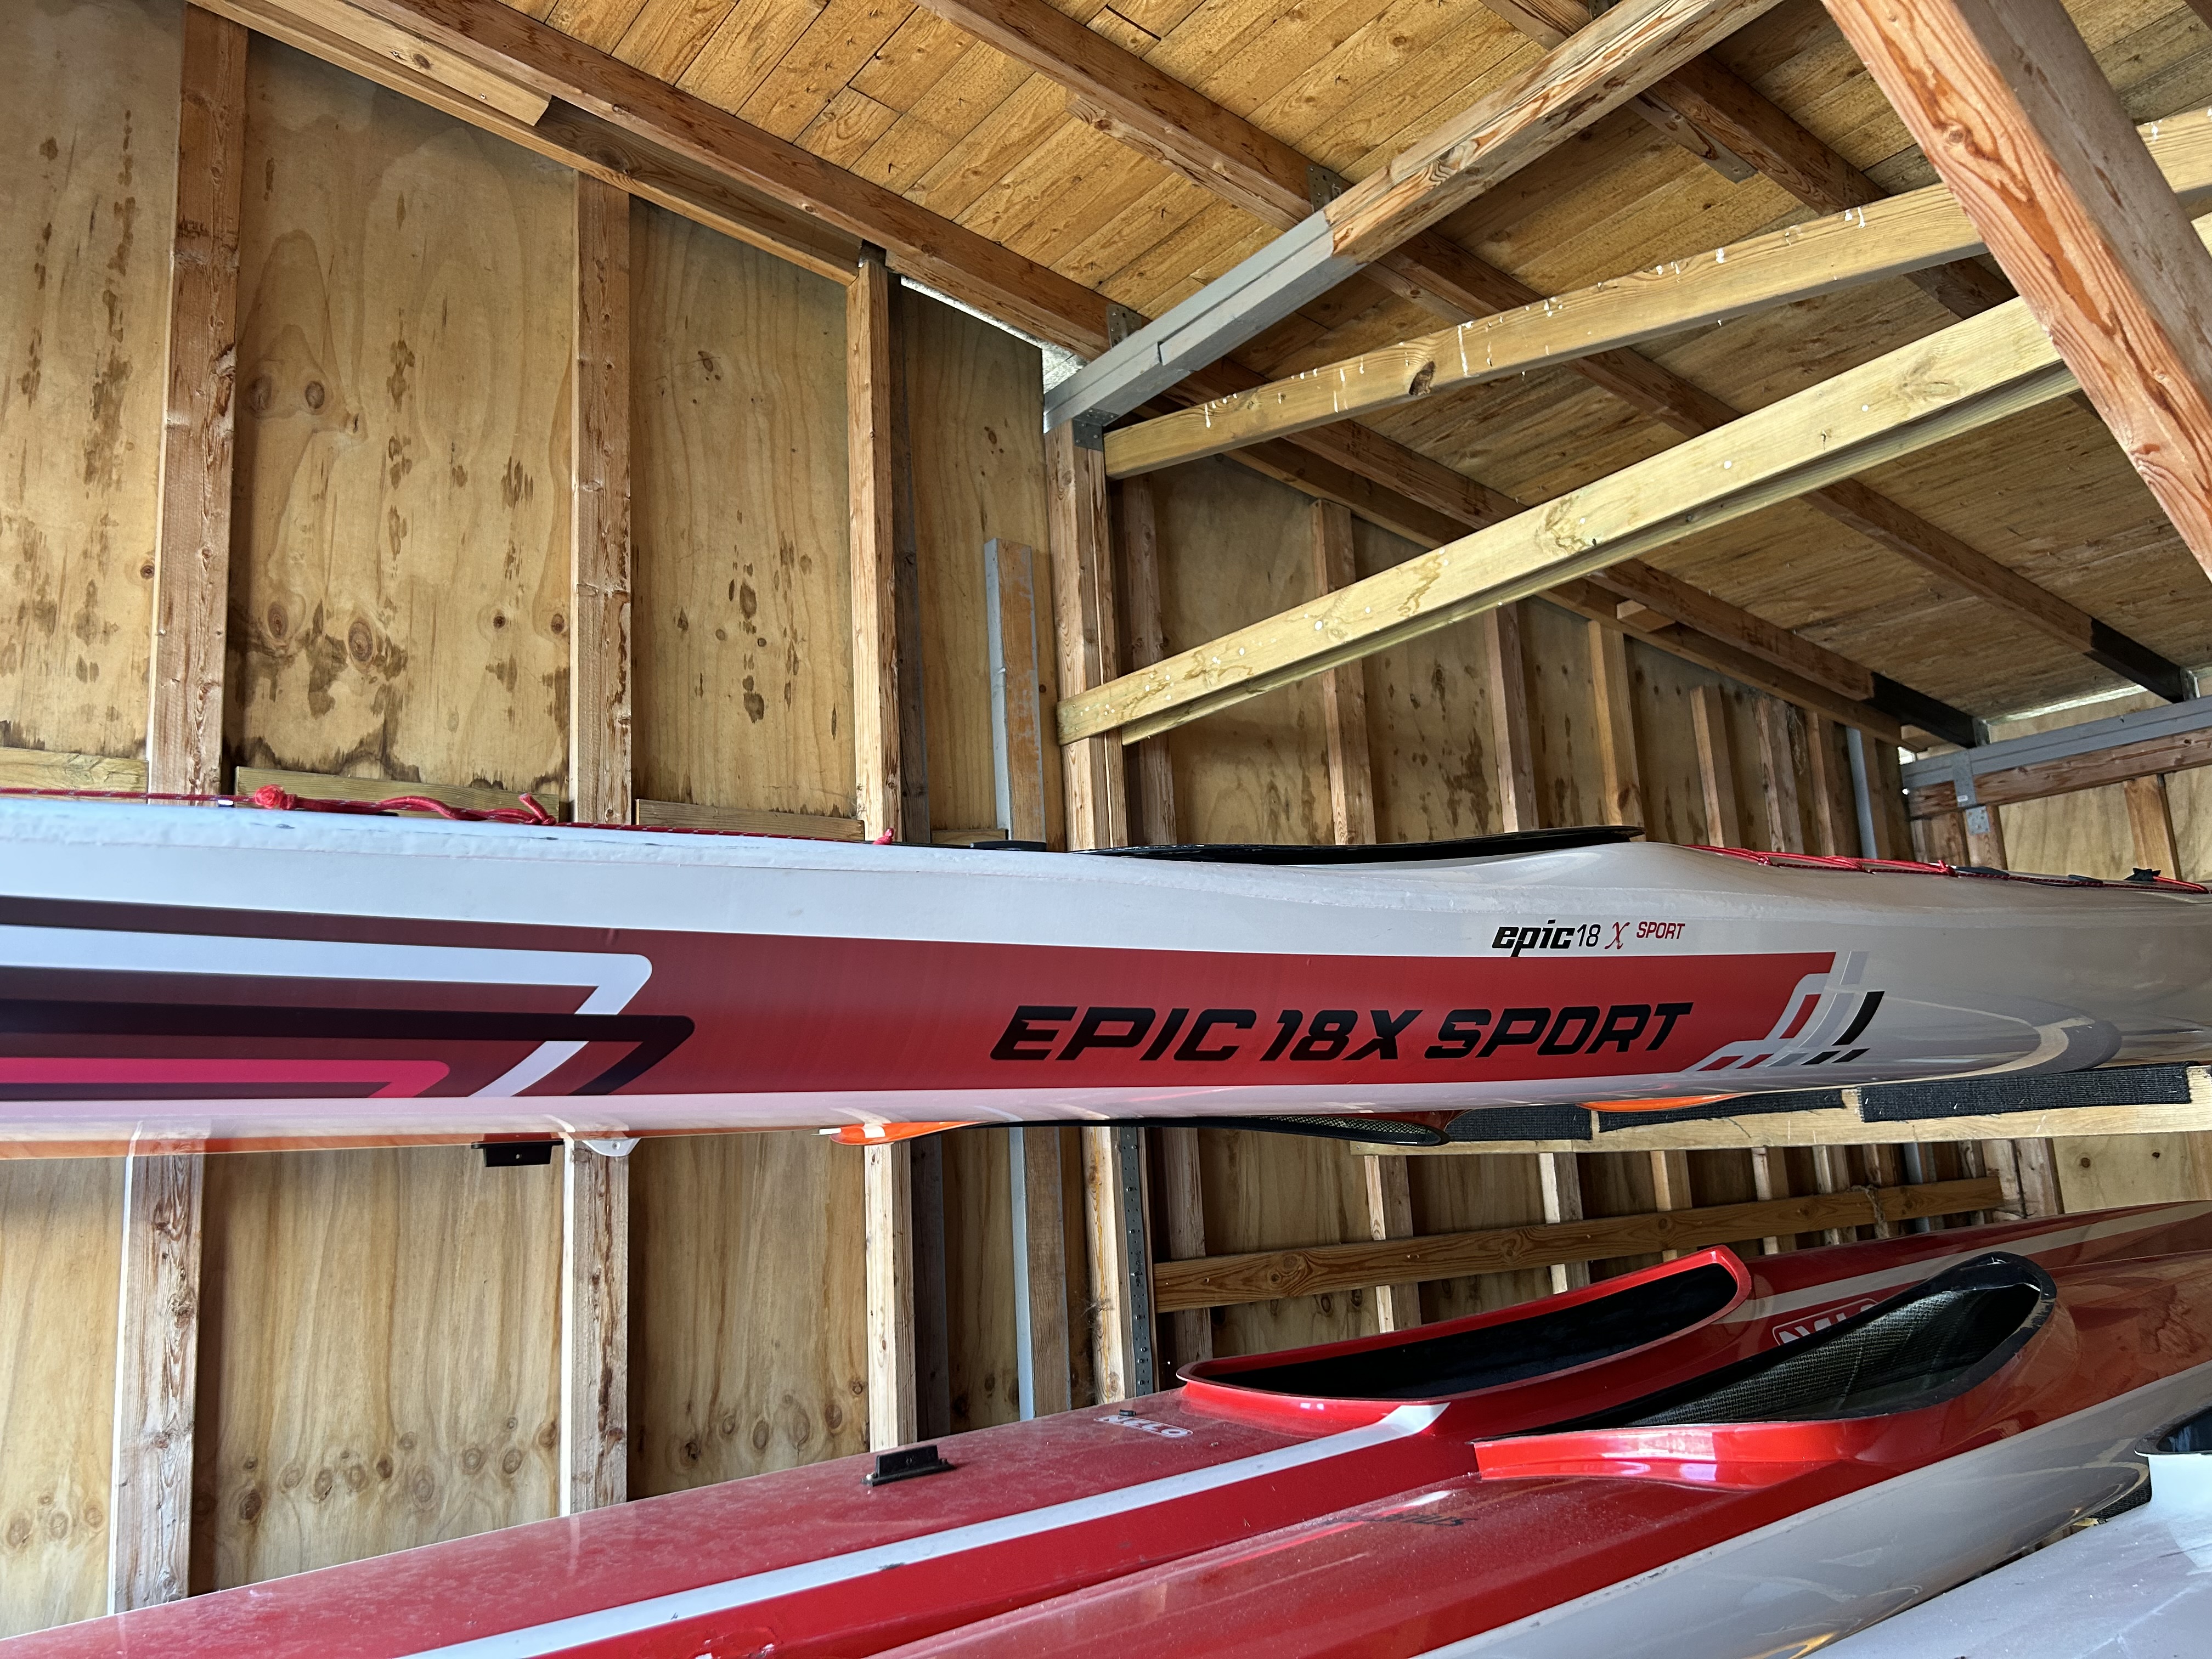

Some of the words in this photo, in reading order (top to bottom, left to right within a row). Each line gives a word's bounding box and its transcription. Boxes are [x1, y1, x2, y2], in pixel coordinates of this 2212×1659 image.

[1636, 921, 1686, 940] SPORT
[990, 1005, 1257, 1062] EPIC
[1259, 1009, 1424, 1062] 18X
[1423, 1002, 1694, 1059] SPORT
